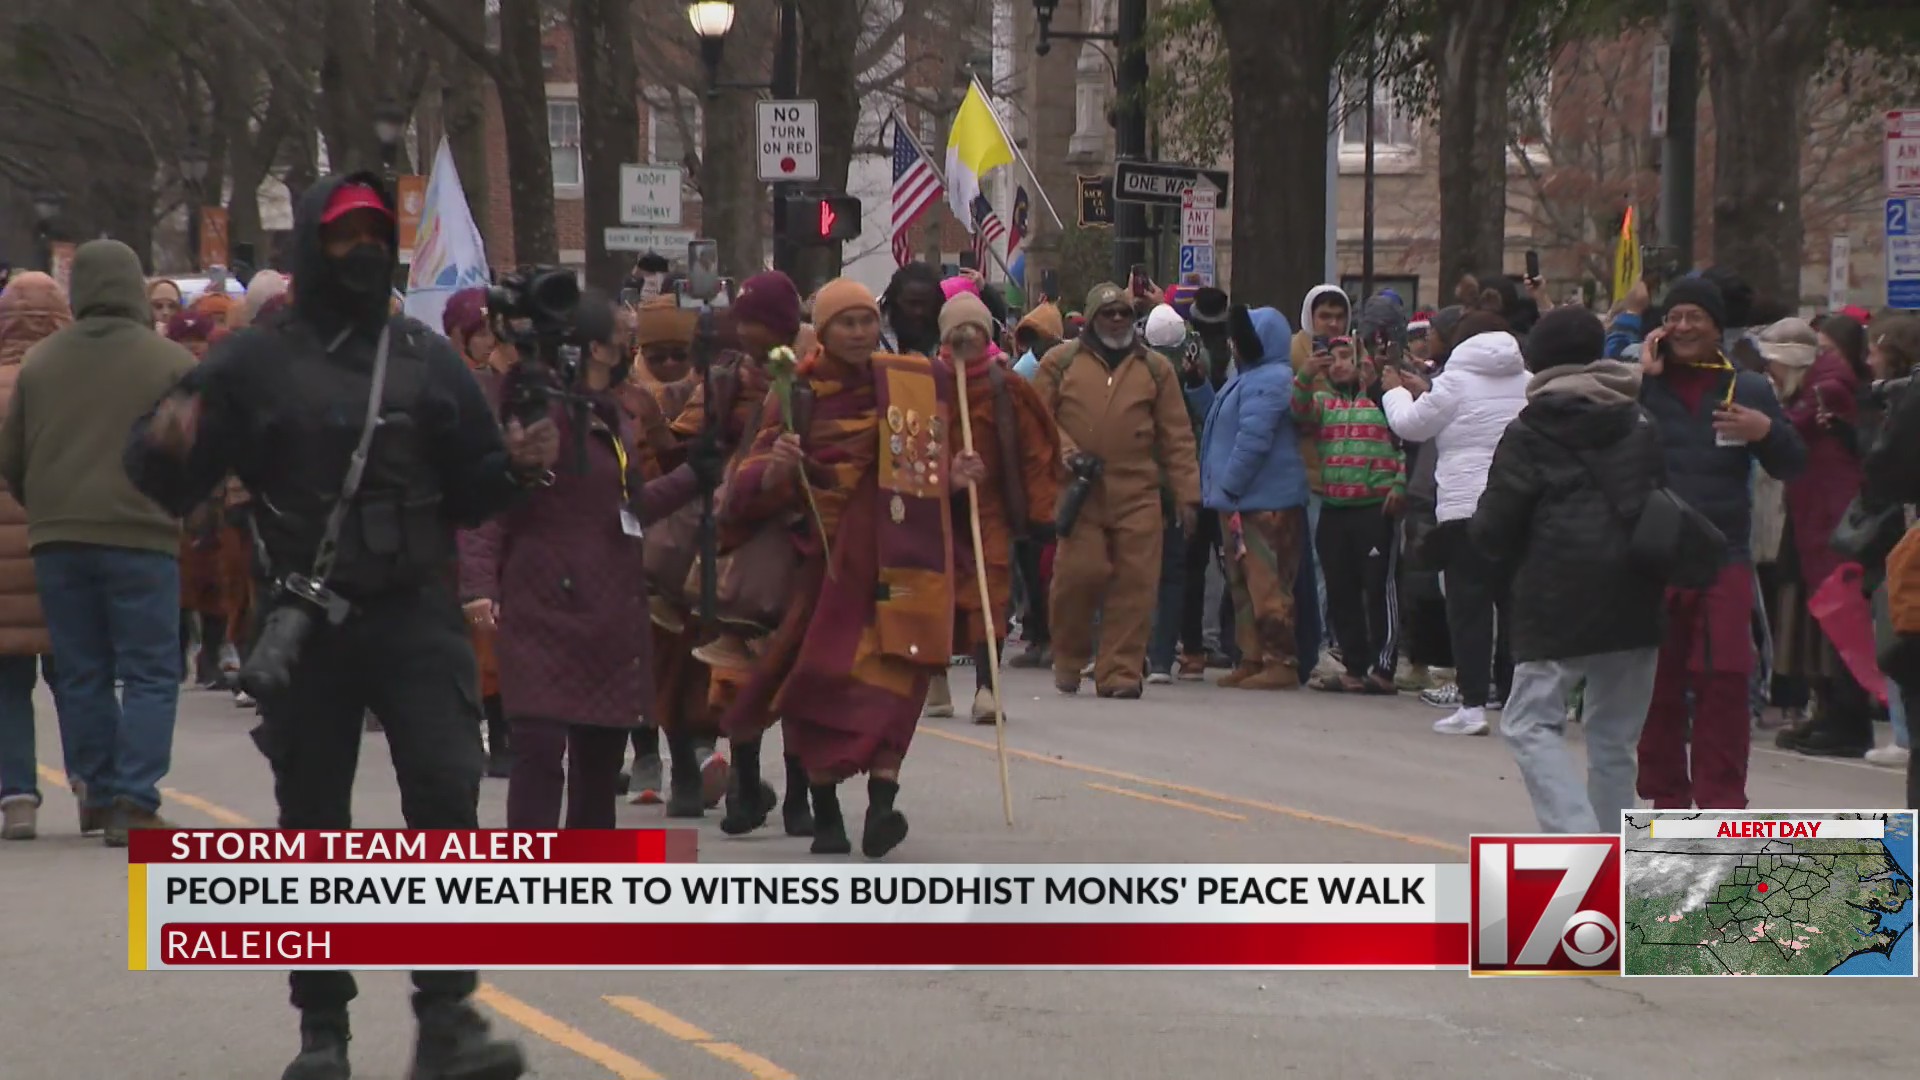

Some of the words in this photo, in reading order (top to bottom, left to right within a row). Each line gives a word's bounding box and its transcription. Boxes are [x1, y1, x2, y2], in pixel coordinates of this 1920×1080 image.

[774, 107, 799, 121] NO
[770, 126, 805, 138] TURN
[763, 143, 781, 154] ON
[787, 142, 812, 153] RED
[636, 173, 666, 185] ADOPT
[1129, 174, 1159, 192] ONE
[1165, 179, 1195, 194] WAY
[648, 190, 654, 201] A
[631, 206, 671, 218] HIGHWAY
[1188, 211, 1209, 222] ANY
[1888, 204, 1905, 230] 2
[1187, 225, 1209, 236] TIME
[1183, 249, 1192, 268] 2
